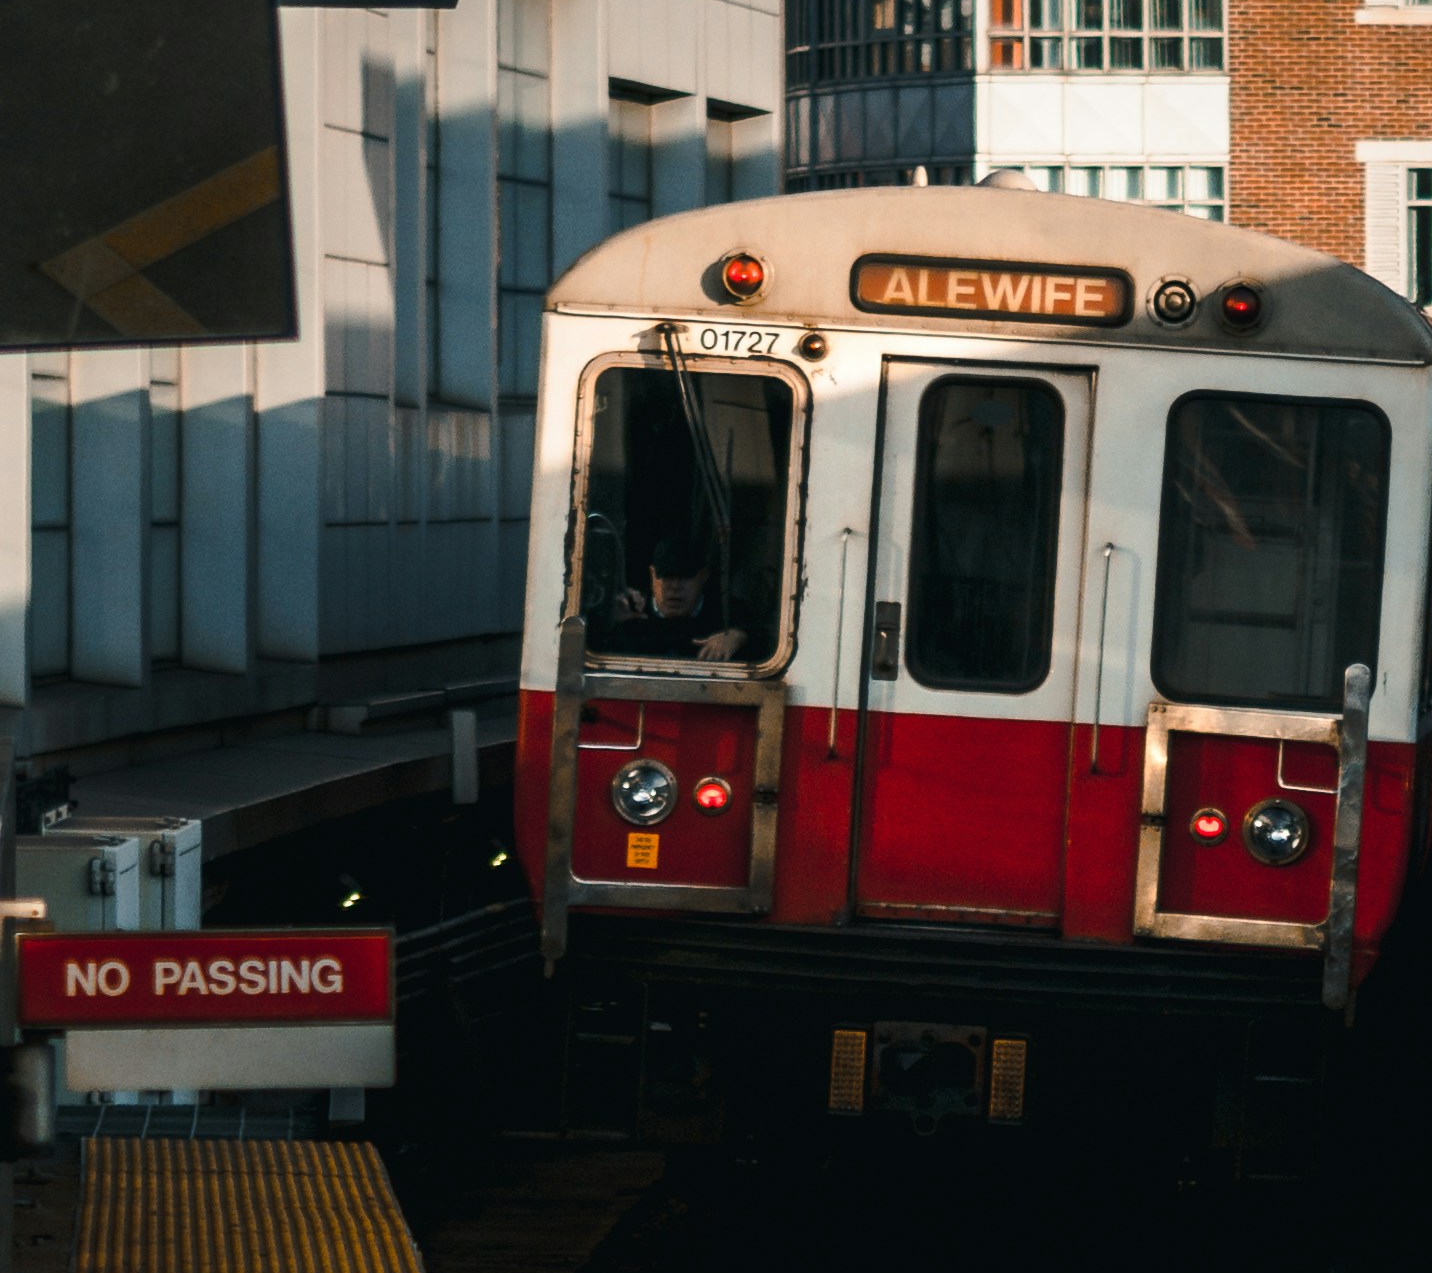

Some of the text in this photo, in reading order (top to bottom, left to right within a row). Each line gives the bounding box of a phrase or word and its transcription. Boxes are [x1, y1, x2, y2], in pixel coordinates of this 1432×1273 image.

[882, 268, 1107, 317] ALEWIFE
[700, 328, 780, 354] 01727
[65, 959, 343, 997] NO PASSING
